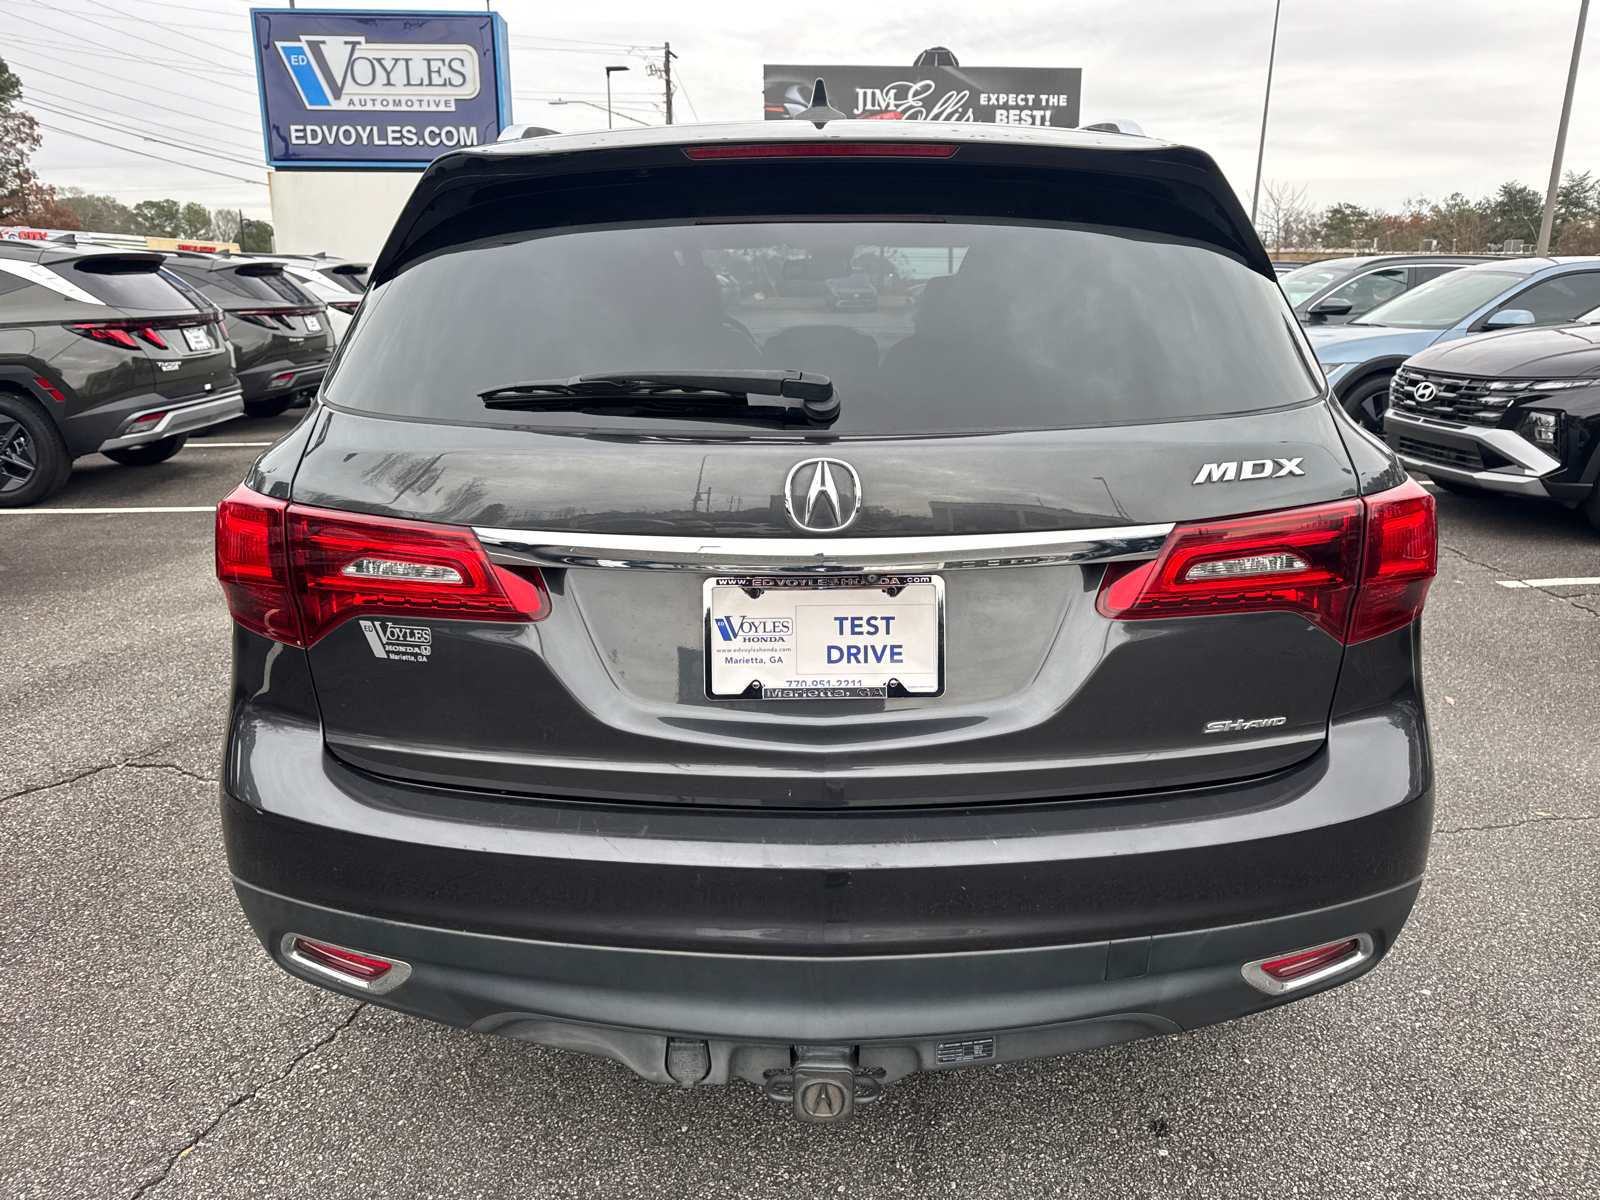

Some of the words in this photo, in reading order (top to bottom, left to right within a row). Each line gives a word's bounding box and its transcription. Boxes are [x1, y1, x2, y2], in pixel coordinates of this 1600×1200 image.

[290, 55, 307, 66] ED
[305, 40, 467, 100] VOYLES
[348, 99, 453, 108] AUTOMOTIVE
[853, 88, 897, 114] JIM
[980, 93, 1036, 106] EXPECT
[1040, 95, 1068, 106] THE
[995, 109, 1052, 126] BEST!
[289, 125, 478, 146] EDVOYLES.COM
[1192, 457, 1305, 485] MDX
[373, 621, 430, 644] VOYLES
[724, 616, 790, 639] VOYLES
[834, 616, 896, 636] TEST
[384, 645, 421, 654] HONDA
[389, 653, 417, 662] Marietta,
[826, 644, 904, 664] DRIVE
[725, 656, 766, 665] Marietta,
[769, 656, 784, 664] GA
[766, 688, 850, 698] Marietta,
[856, 687, 884, 697] GA
[1203, 716, 1287, 734] SH-AWD
